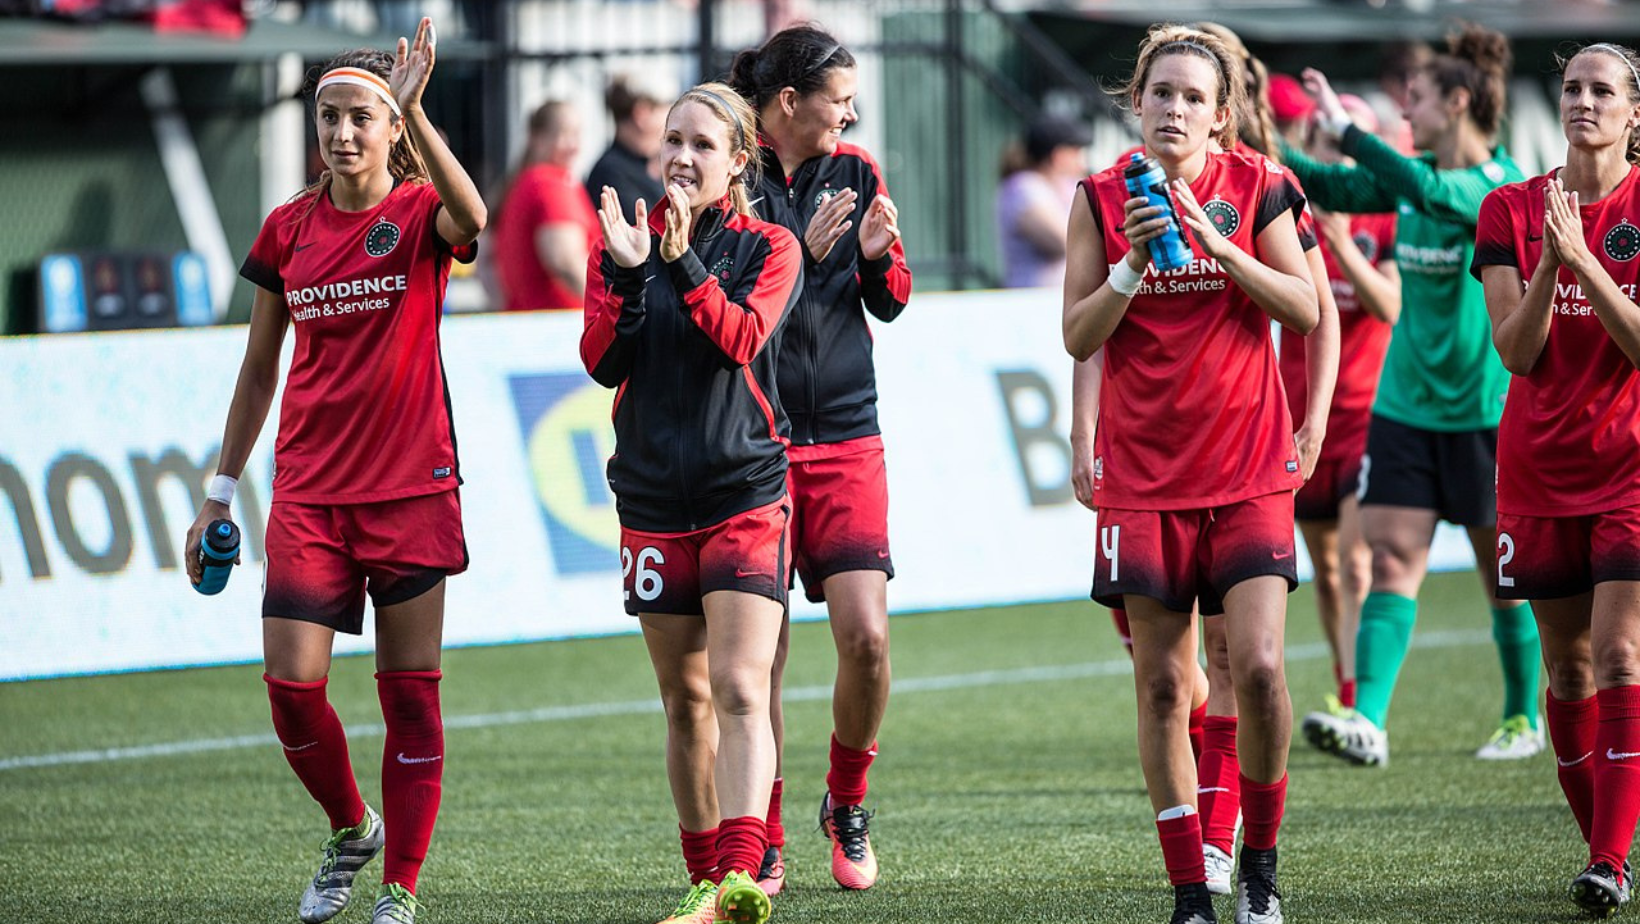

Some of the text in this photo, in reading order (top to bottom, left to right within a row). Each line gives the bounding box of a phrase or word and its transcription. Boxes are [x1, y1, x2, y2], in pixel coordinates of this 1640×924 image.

[286, 274, 407, 307] PROVIDENCE
[323, 303, 335, 317] &
[336, 297, 390, 315] Services
[1154, 281, 1167, 294] &
[1169, 277, 1226, 293] Services
[996, 370, 1075, 507] B
[621, 545, 665, 601] 26
[1101, 524, 1120, 582] 4
[1498, 531, 1516, 587] 2
